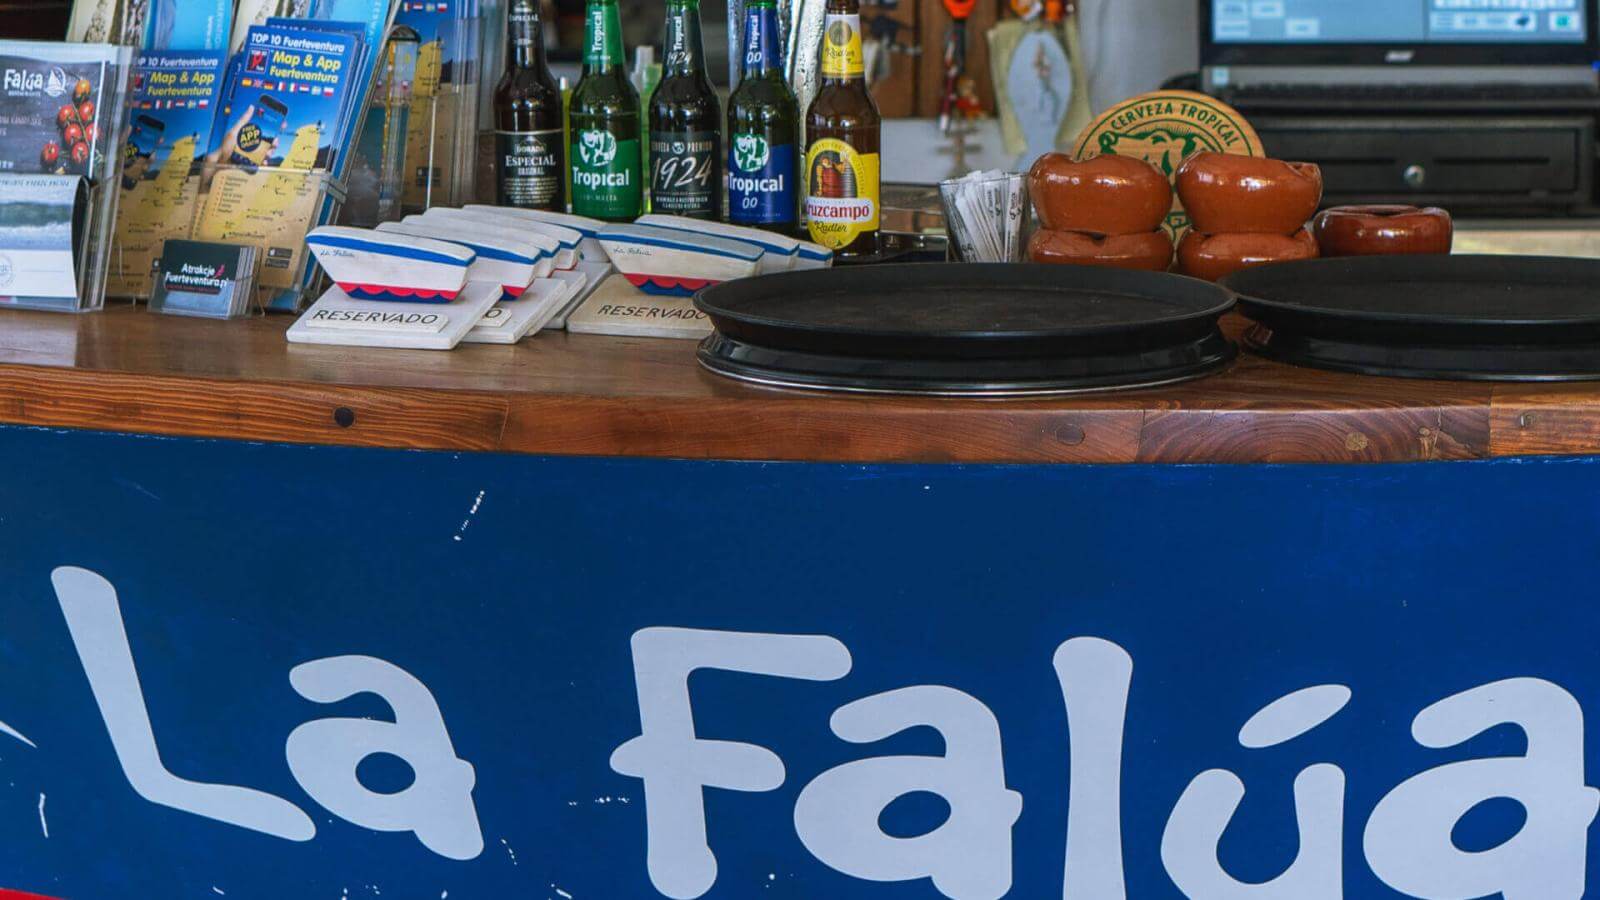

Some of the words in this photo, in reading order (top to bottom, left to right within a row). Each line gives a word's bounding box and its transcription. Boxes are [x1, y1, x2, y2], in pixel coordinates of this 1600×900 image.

[592, 11, 605, 52] Tropical
[673, 16, 684, 50] Tropical
[749, 15, 760, 50] Tropical
[251, 33, 269, 44] TOP
[270, 35, 282, 45] 10
[283, 37, 345, 53] Fuerteventura
[160, 57, 218, 67] Fuerteventura
[272, 50, 301, 67] Map
[303, 54, 314, 67] &
[316, 55, 341, 72] App
[666, 51, 692, 65] 1924
[150, 71, 176, 86] Map
[180, 71, 189, 83] &
[192, 72, 215, 86] App
[269, 65, 338, 83] Fuerteventura
[147, 86, 213, 96] Fuerteventura
[1111, 102, 1174, 130] CERVEZA
[1180, 103, 1240, 147] TROPICAL
[240, 129, 260, 143] APP
[505, 154, 556, 167] ESPECIAL
[572, 166, 630, 190] Tropical
[652, 155, 713, 190] 1924
[728, 171, 784, 196] Tropical
[806, 204, 870, 221] ruzcampo
[181, 263, 215, 277] Atrakcje
[312, 309, 439, 324] RESERVADO
[597, 304, 706, 320] RESERVADO
[50, 565, 484, 861] La
[609, 626, 1600, 900] Falúa
